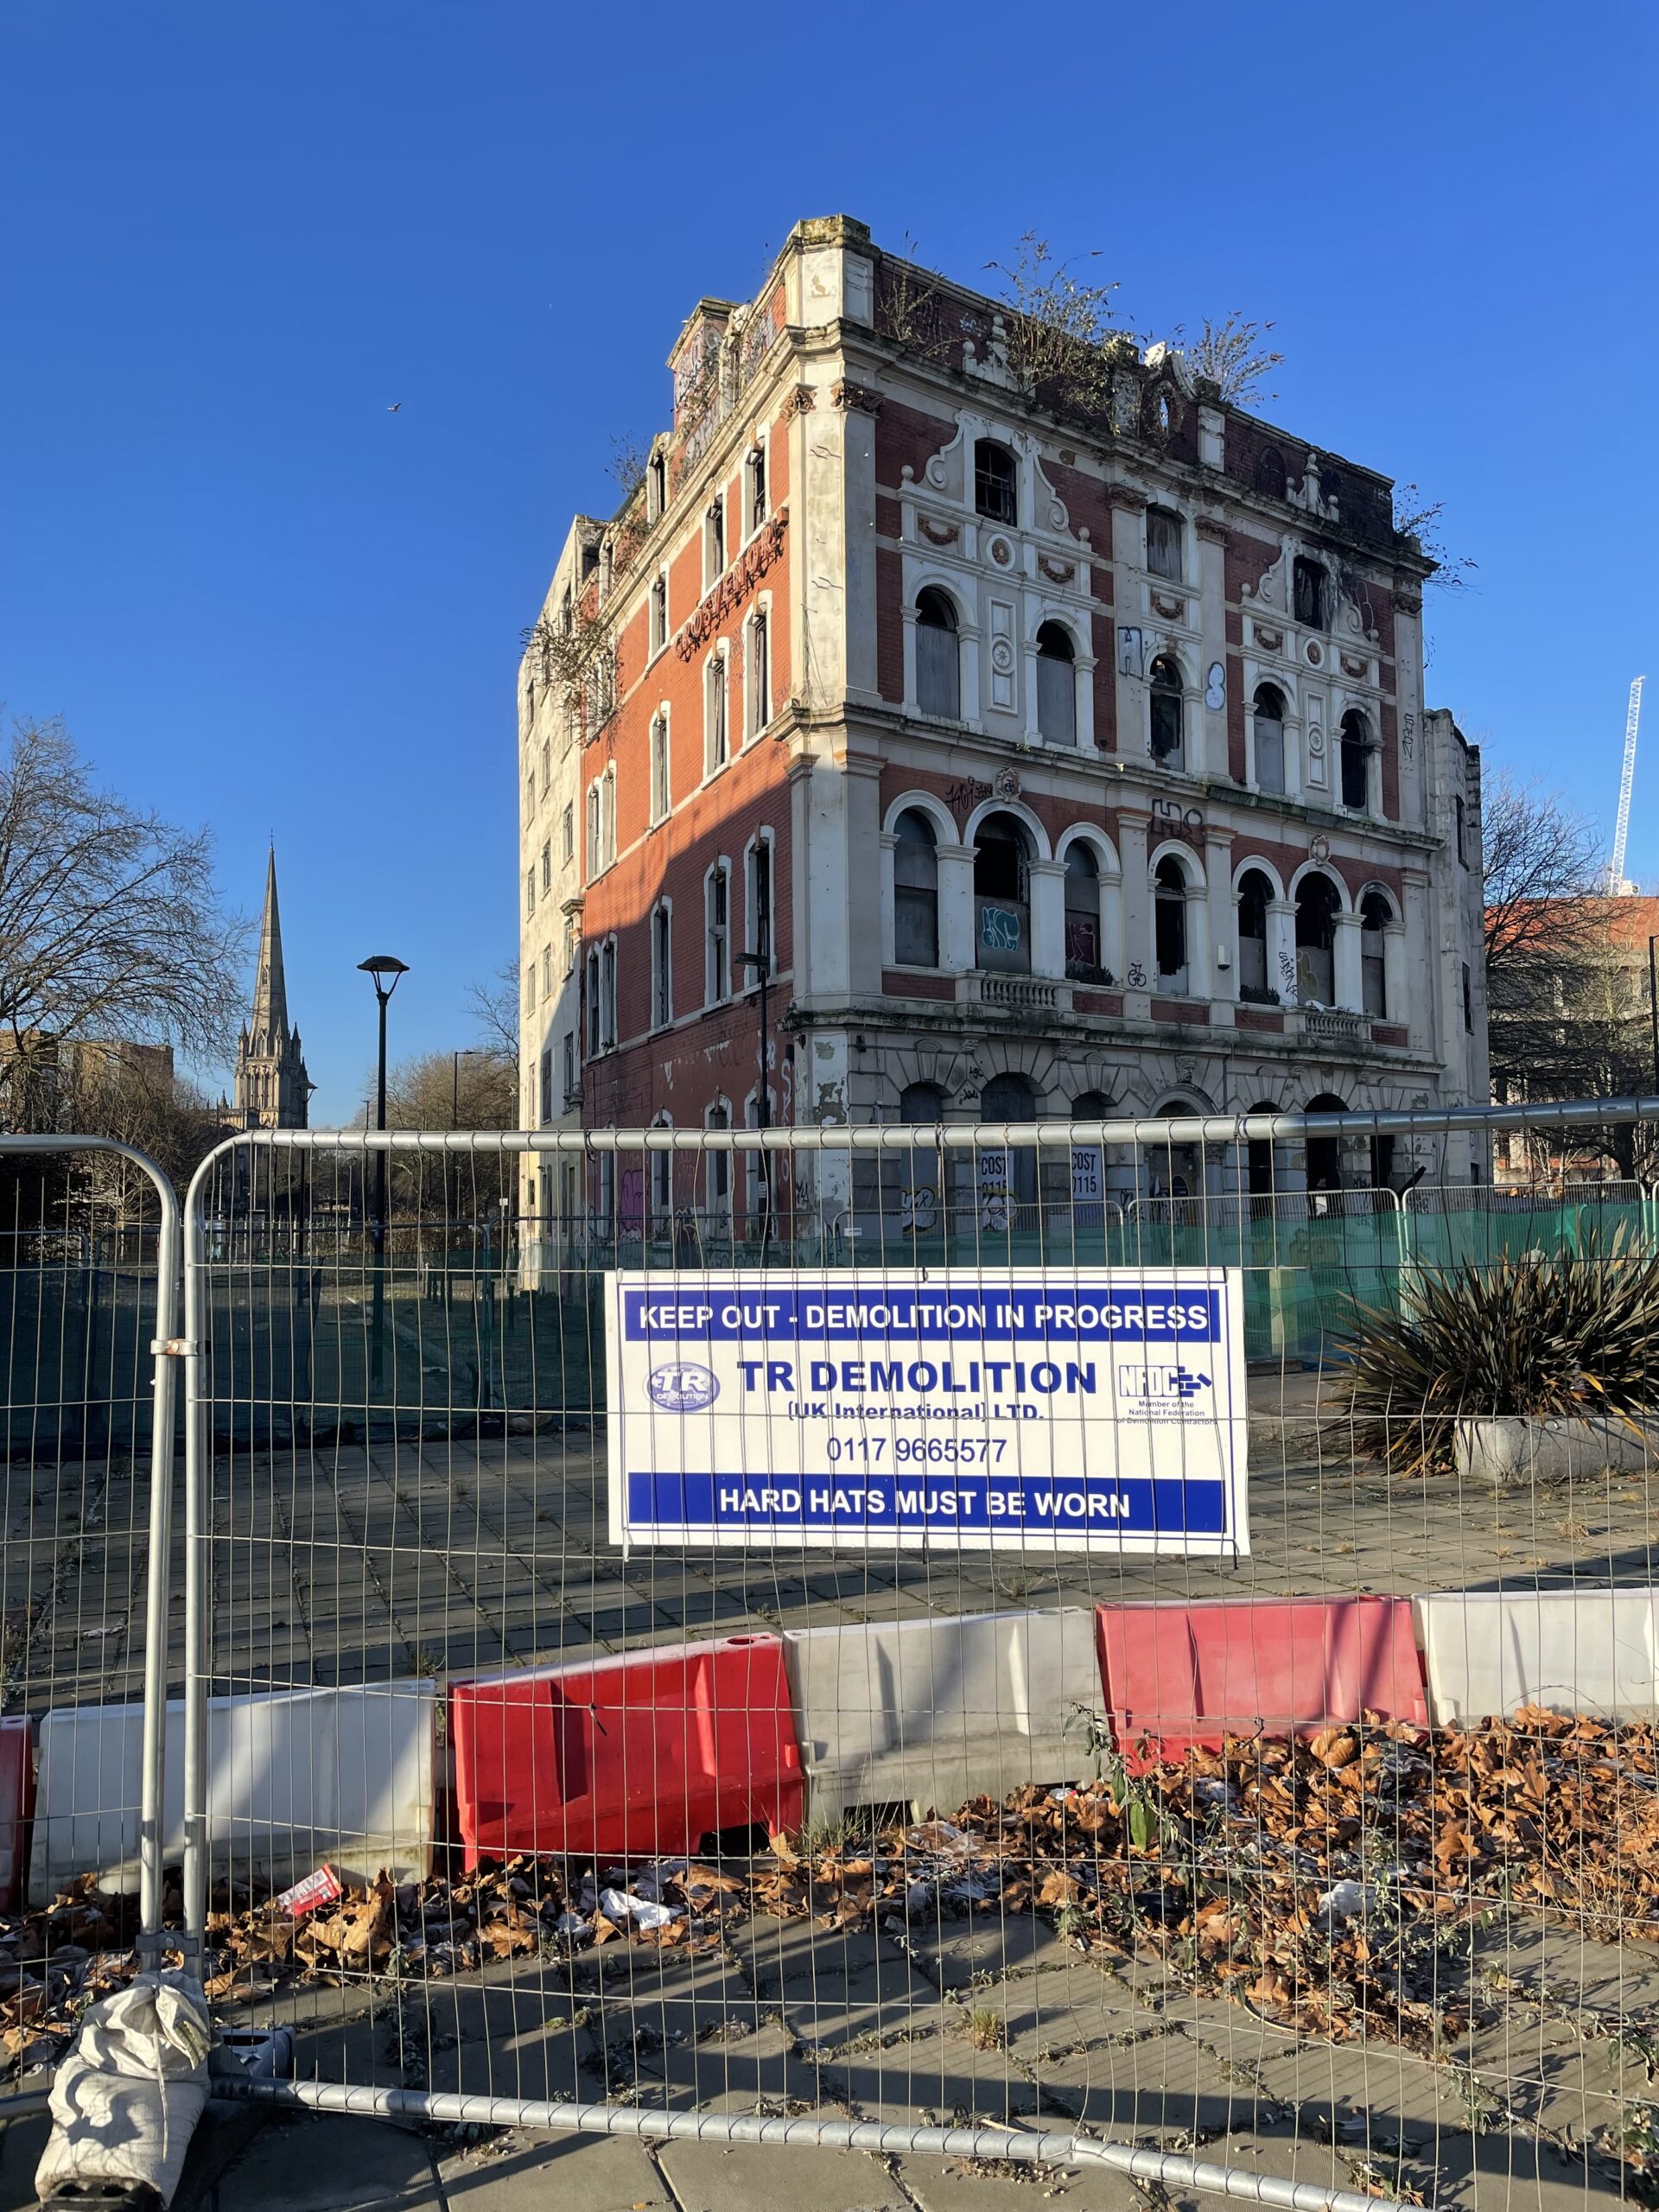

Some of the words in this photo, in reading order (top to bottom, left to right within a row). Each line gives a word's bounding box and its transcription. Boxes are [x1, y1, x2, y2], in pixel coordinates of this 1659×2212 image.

[1071, 1152, 1096, 1173] COST
[639, 1306, 714, 1329] KEEP
[721, 1305, 780, 1329] OUT
[806, 1305, 987, 1329] DEMOLITION
[996, 1305, 1025, 1329] IN
[1035, 1305, 1209, 1330] PROGRESS
[657, 1371, 709, 1392] TR
[737, 1361, 796, 1392] TR
[810, 1361, 1096, 1394] DEMOLITION
[1119, 1365, 1179, 1397] NFDC
[994, 1403, 1045, 1420] LTD.
[826, 1437, 887, 1462] 0117
[895, 1437, 1007, 1463] 9665577
[720, 1488, 802, 1512] HARD
[810, 1489, 886, 1514] HATS
[897, 1491, 977, 1516] MUST
[986, 1491, 1027, 1516] BE
[1033, 1492, 1131, 1518] WORN
